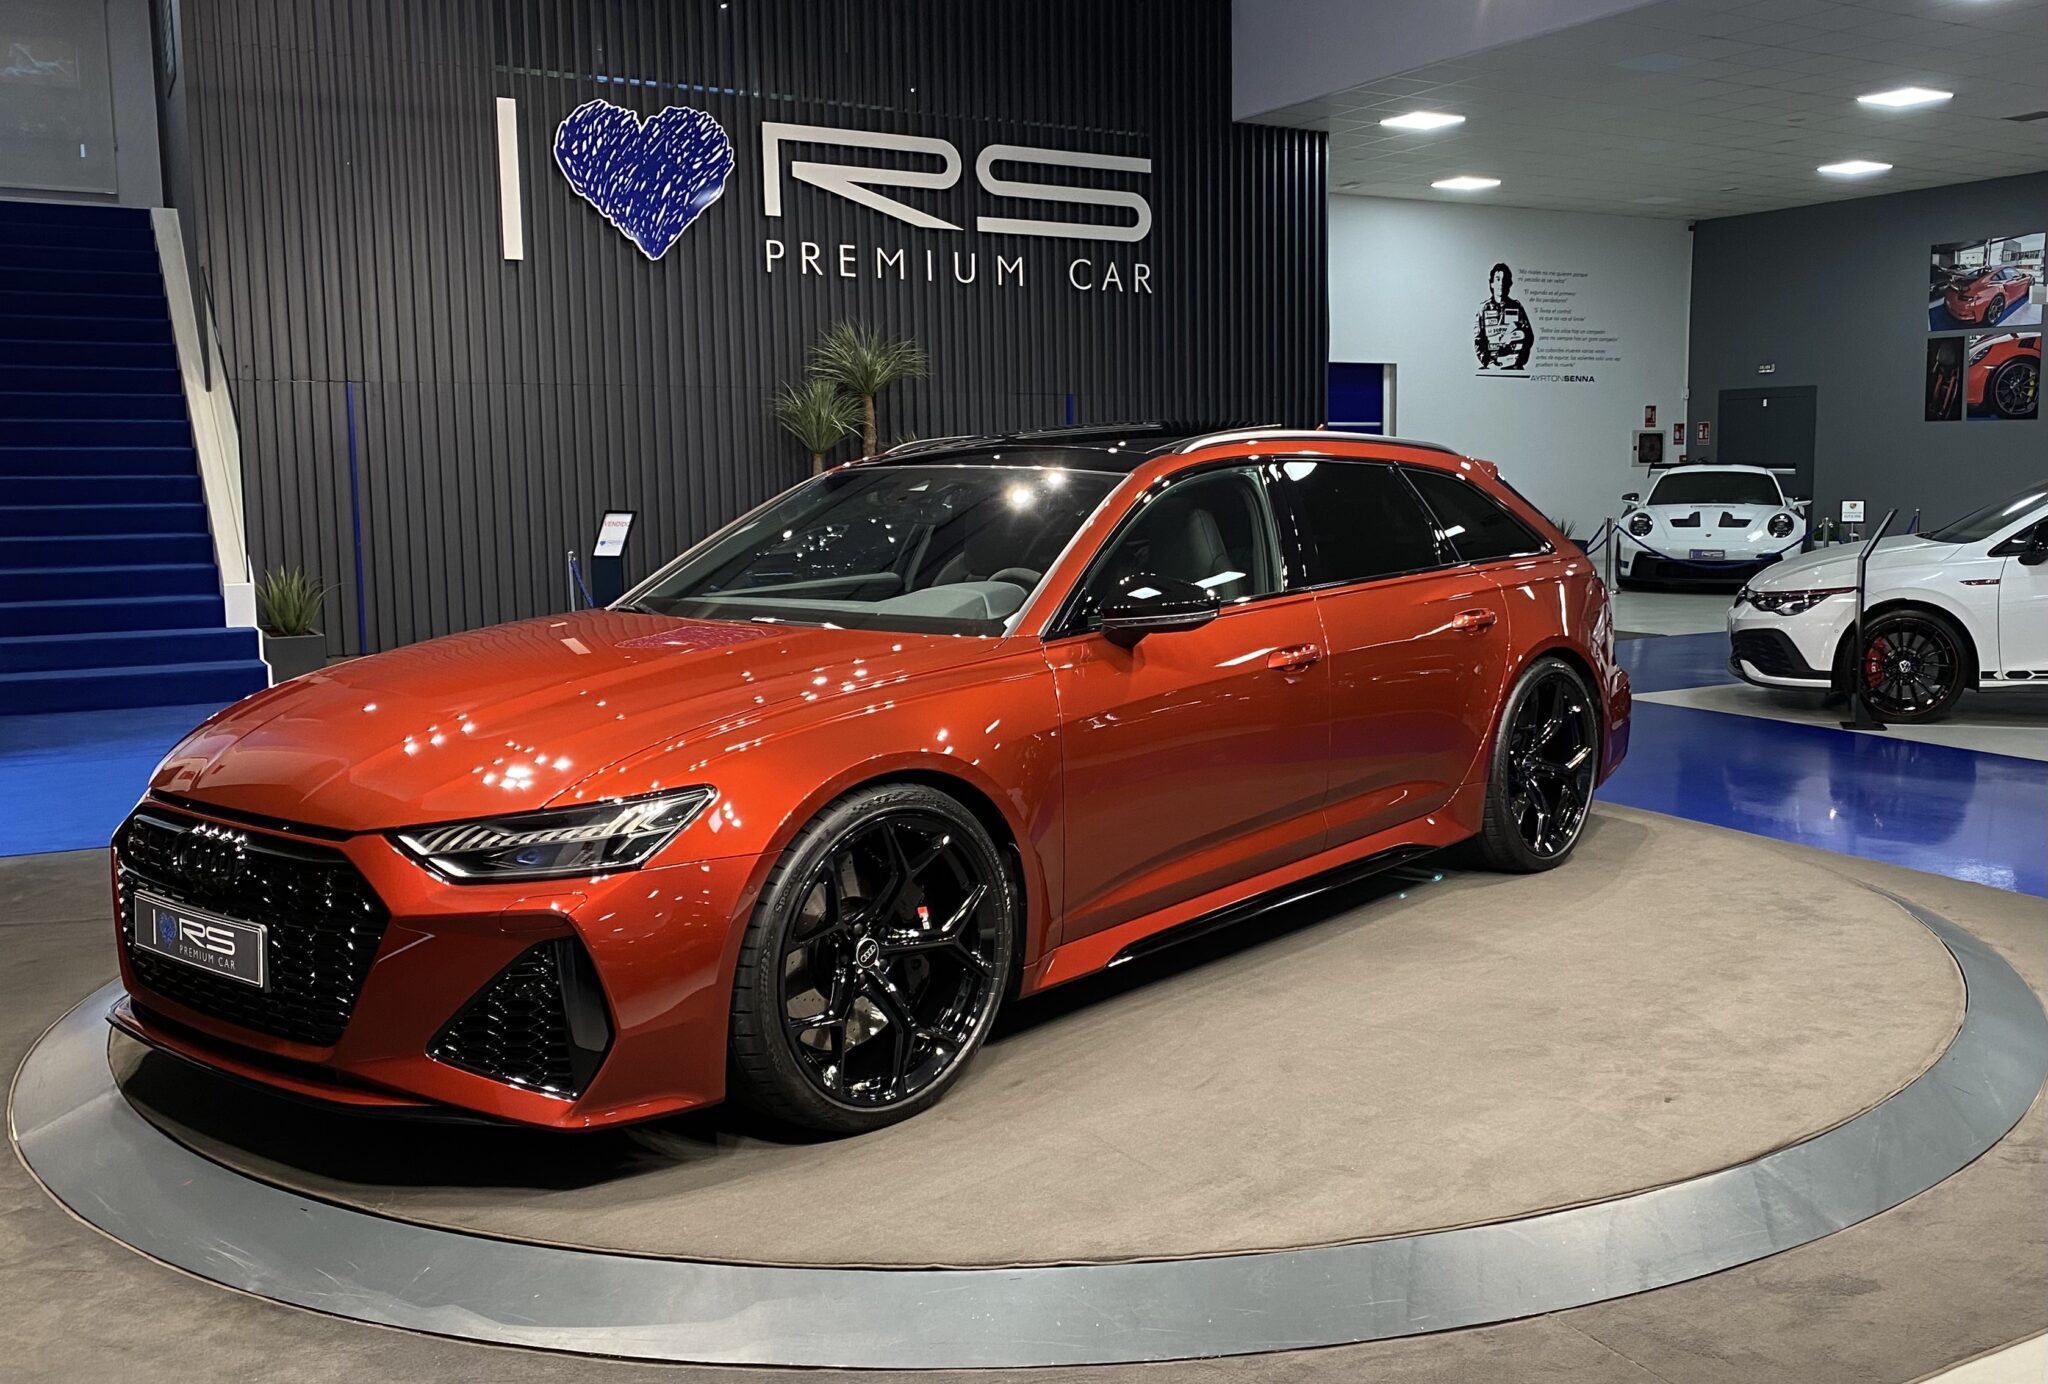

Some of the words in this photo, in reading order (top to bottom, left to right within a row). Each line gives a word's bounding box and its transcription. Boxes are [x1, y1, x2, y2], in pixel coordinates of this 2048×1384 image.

[496, 97, 524, 261] I
[762, 121, 1152, 242] RS
[766, 239, 1025, 287] PREMIUM
[1069, 258, 1152, 294] CAR
[179, 918, 235, 956] RS
[179, 944, 214, 964] PREMIUM
[218, 956, 236, 970] CAR
